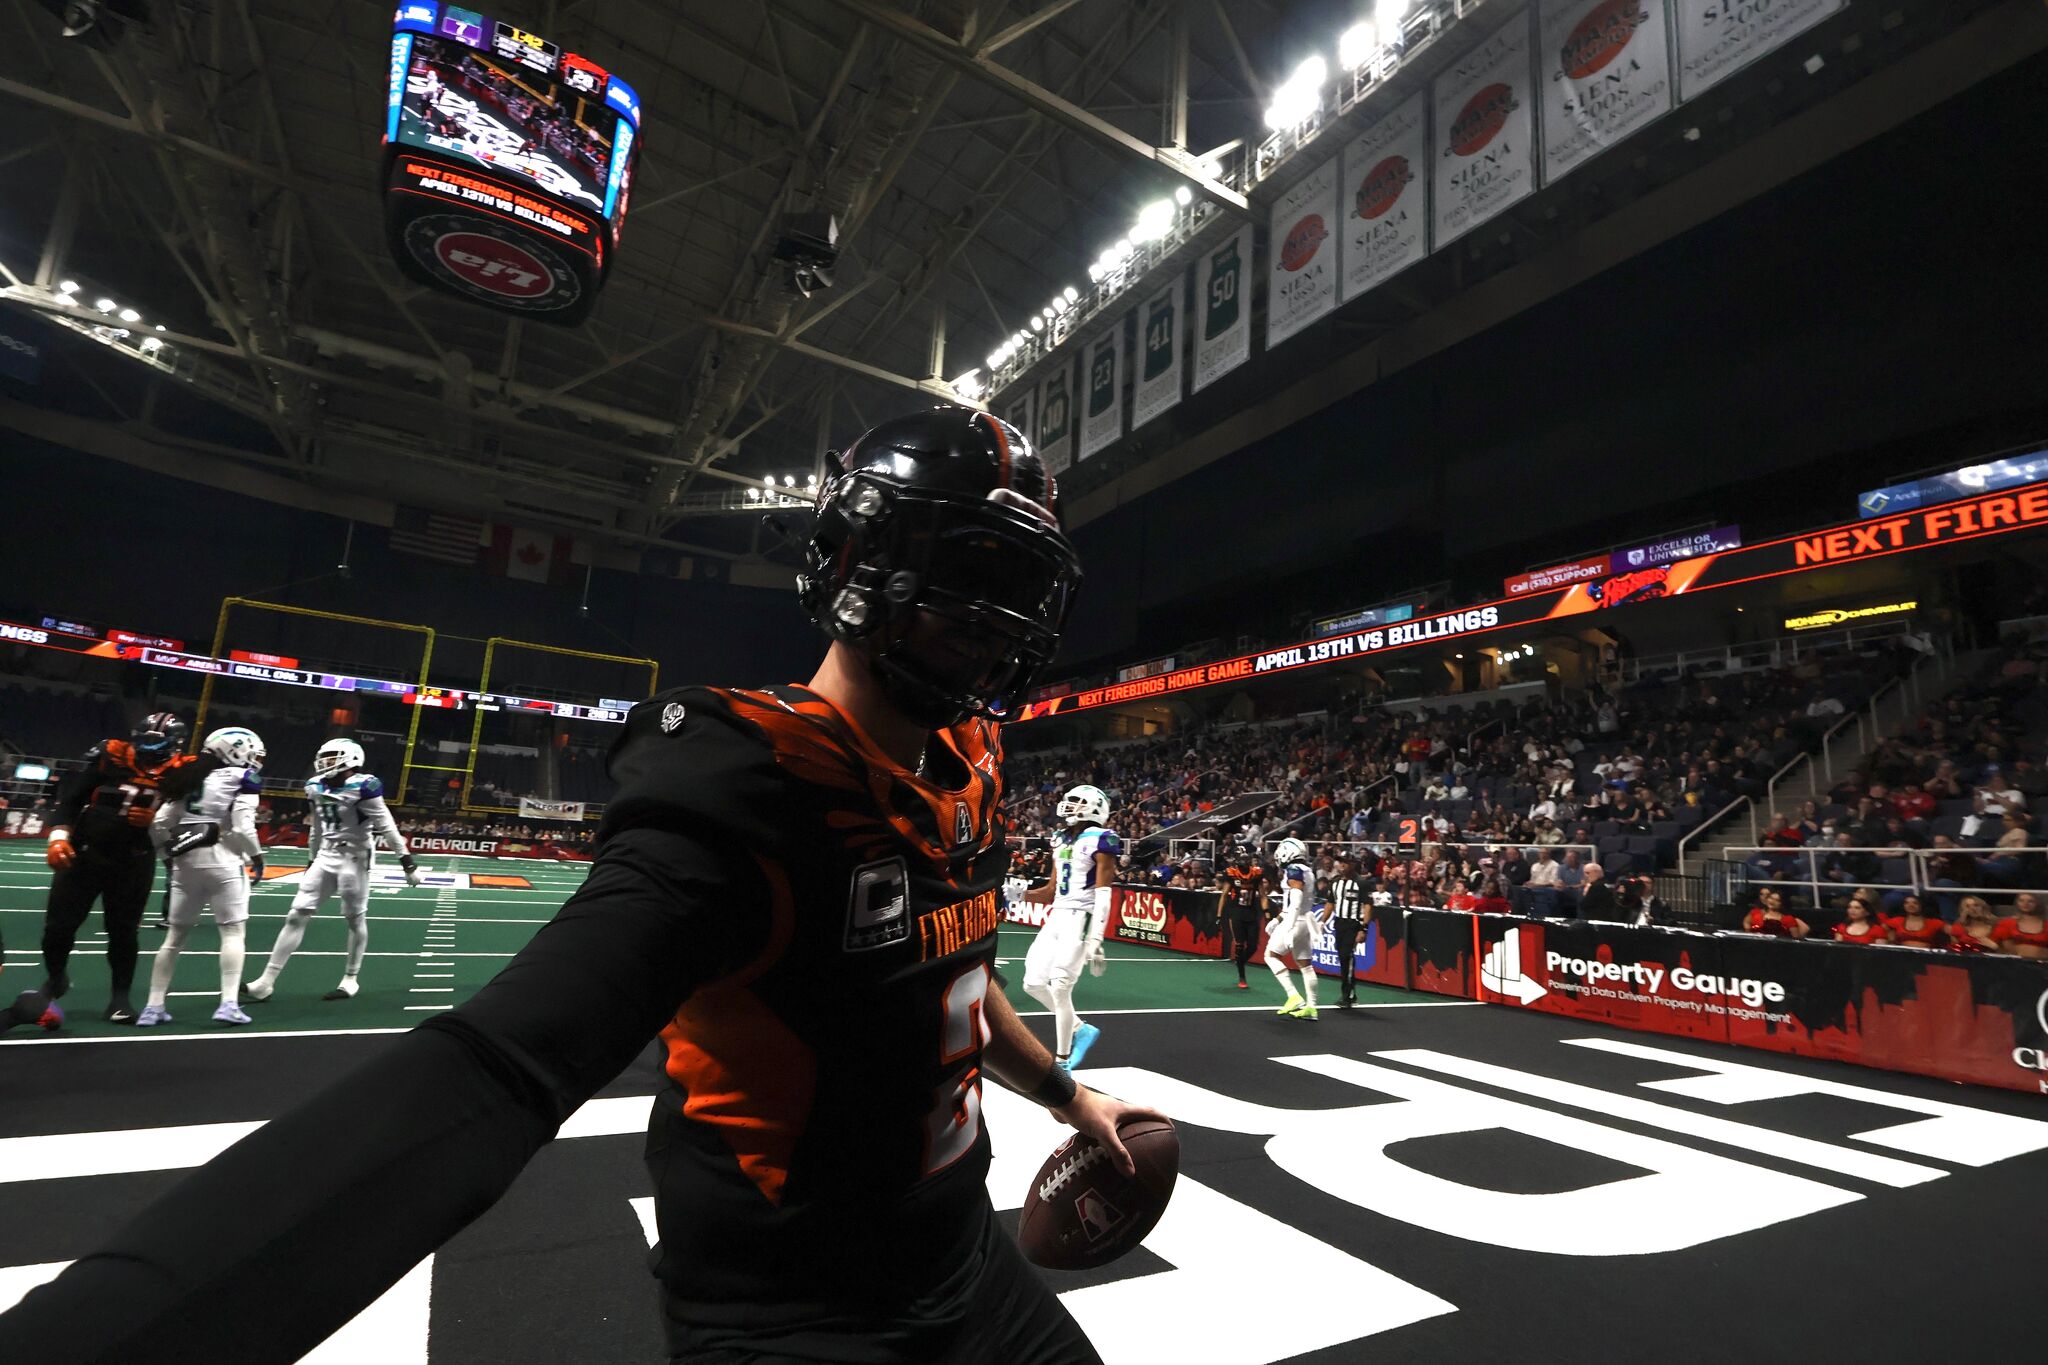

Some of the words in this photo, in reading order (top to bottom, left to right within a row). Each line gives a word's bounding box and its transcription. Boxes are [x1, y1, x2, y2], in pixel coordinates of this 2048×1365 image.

[456, 21, 467, 36] 7
[1562, 55, 1640, 118] SIENA
[1450, 139, 1510, 191] SIENA
[407, 164, 441, 180] NEXT
[513, 195, 551, 216] HOME
[419, 178, 460, 196] APRIL
[495, 199, 514, 213] VS
[1355, 207, 1407, 251] SIENA
[1211, 268, 1235, 309] 50
[1279, 262, 1322, 300] SIENA
[1147, 316, 1171, 352] 41
[1649, 534, 1711, 555] EXCELSIOR
[1794, 518, 1912, 566] NEXT
[1511, 581, 1529, 593] Call
[1553, 565, 1604, 583] SUPPORT
[235, 664, 271, 679] BALL
[304, 673, 315, 685] 1
[1078, 687, 1104, 708] NEXT
[1105, 676, 1166, 702] FIREBIRDS
[1167, 666, 1206, 690] HOME
[1207, 657, 1254, 682] GAME:
[1255, 649, 1304, 673] APRIL
[1307, 637, 1354, 663] 13TH
[1357, 631, 1384, 652] VS
[1388, 605, 1499, 647] BILLINGS
[410, 836, 499, 853] CHEVROLET
[1398, 818, 1418, 844] 2
[854, 864, 905, 928] C
[1059, 863, 1072, 896] 3
[1123, 890, 1165, 922] RSG
[1319, 952, 1342, 967] BEE
[1546, 950, 1665, 995] Property
[1670, 966, 1787, 1008] Gauge
[1548, 979, 1591, 997] Powering
[1591, 986, 1617, 999] Data
[1618, 989, 1653, 1004] Driven
[1653, 994, 1703, 1013] Property
[1704, 1001, 1792, 1024] Management
